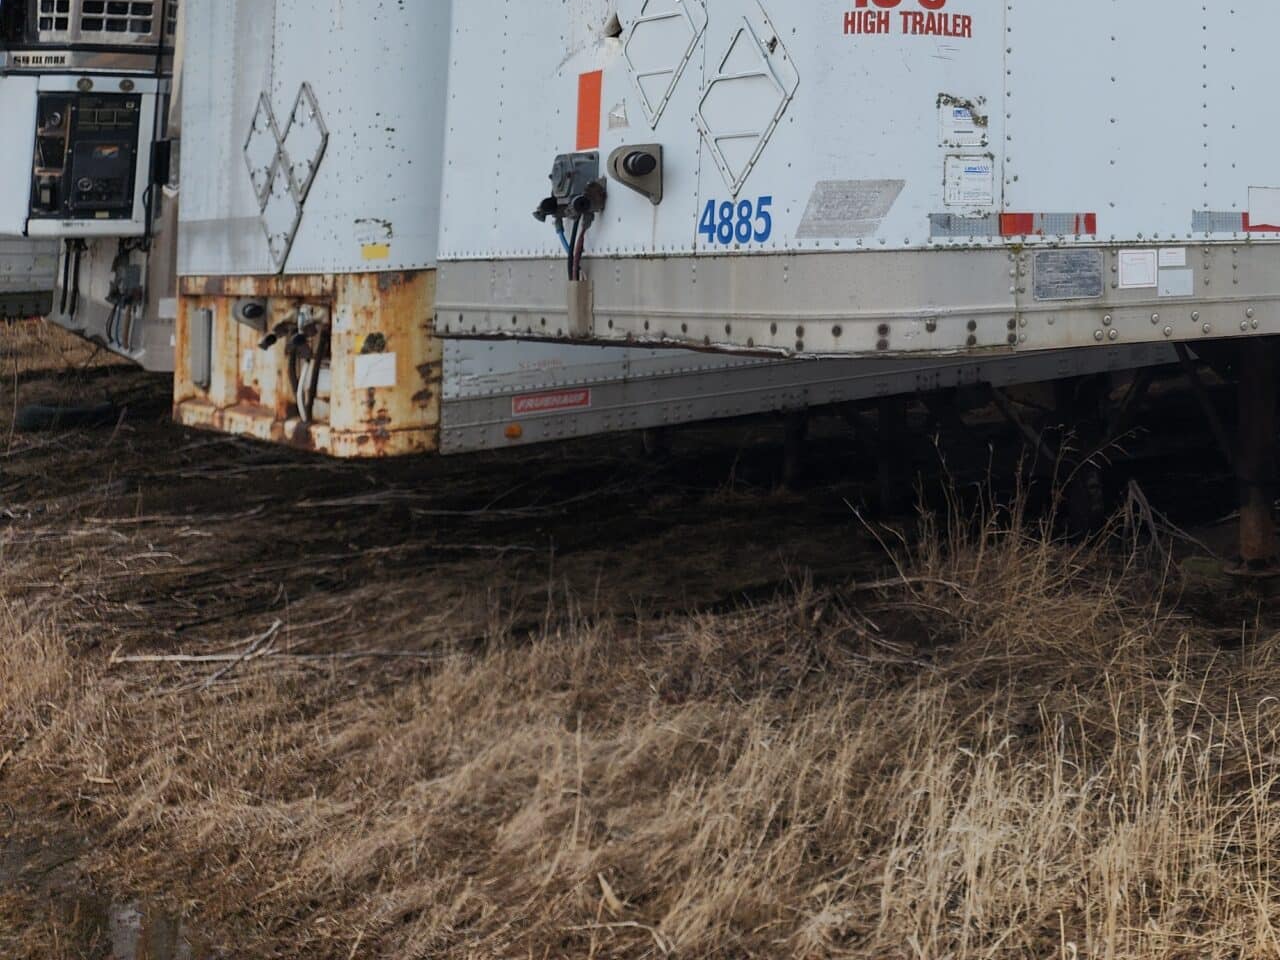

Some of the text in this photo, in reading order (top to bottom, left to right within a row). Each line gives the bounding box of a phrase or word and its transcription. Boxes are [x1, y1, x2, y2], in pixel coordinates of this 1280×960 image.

[843, 10, 973, 38] HIGH TRAILER
[698, 195, 773, 244] 4885
